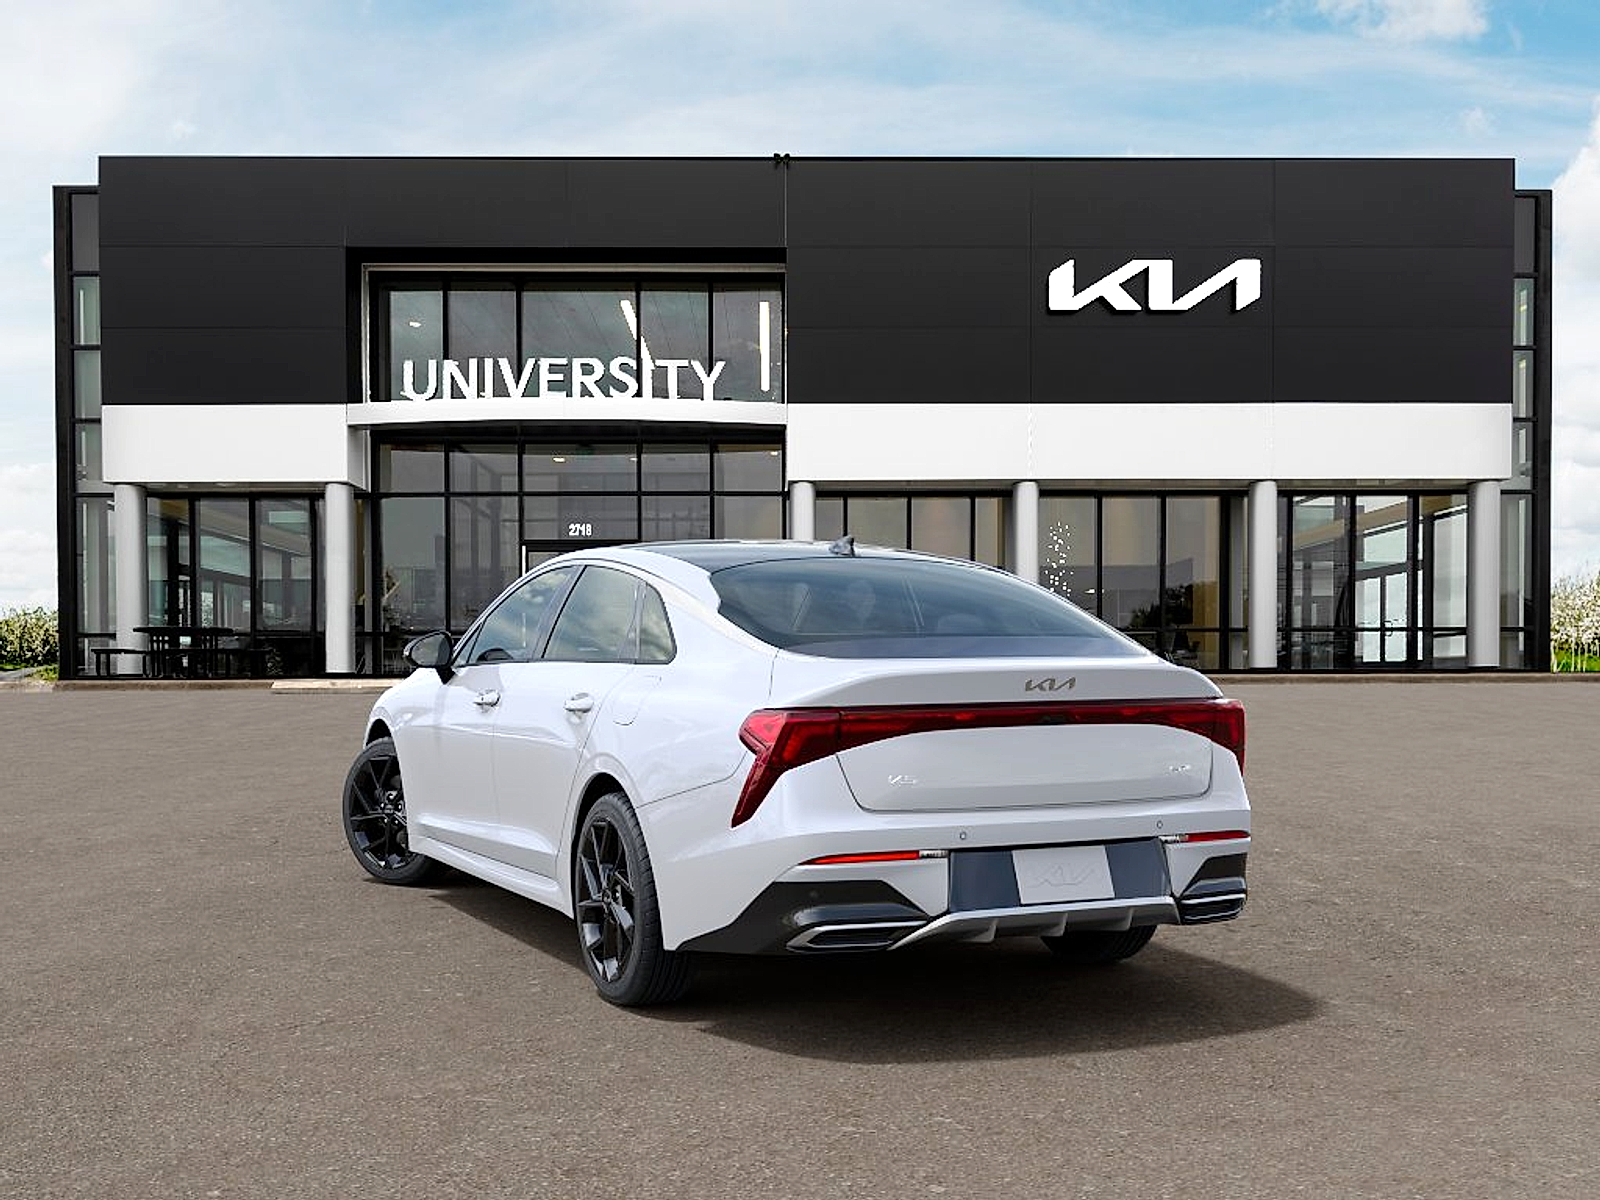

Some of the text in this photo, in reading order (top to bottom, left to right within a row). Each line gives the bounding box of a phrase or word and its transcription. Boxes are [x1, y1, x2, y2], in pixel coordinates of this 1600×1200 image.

[1048, 259, 1261, 311] KIA
[401, 357, 727, 401] UNIVERSITY
[568, 523, 592, 536] 2718
[1025, 677, 1076, 691] KIA
